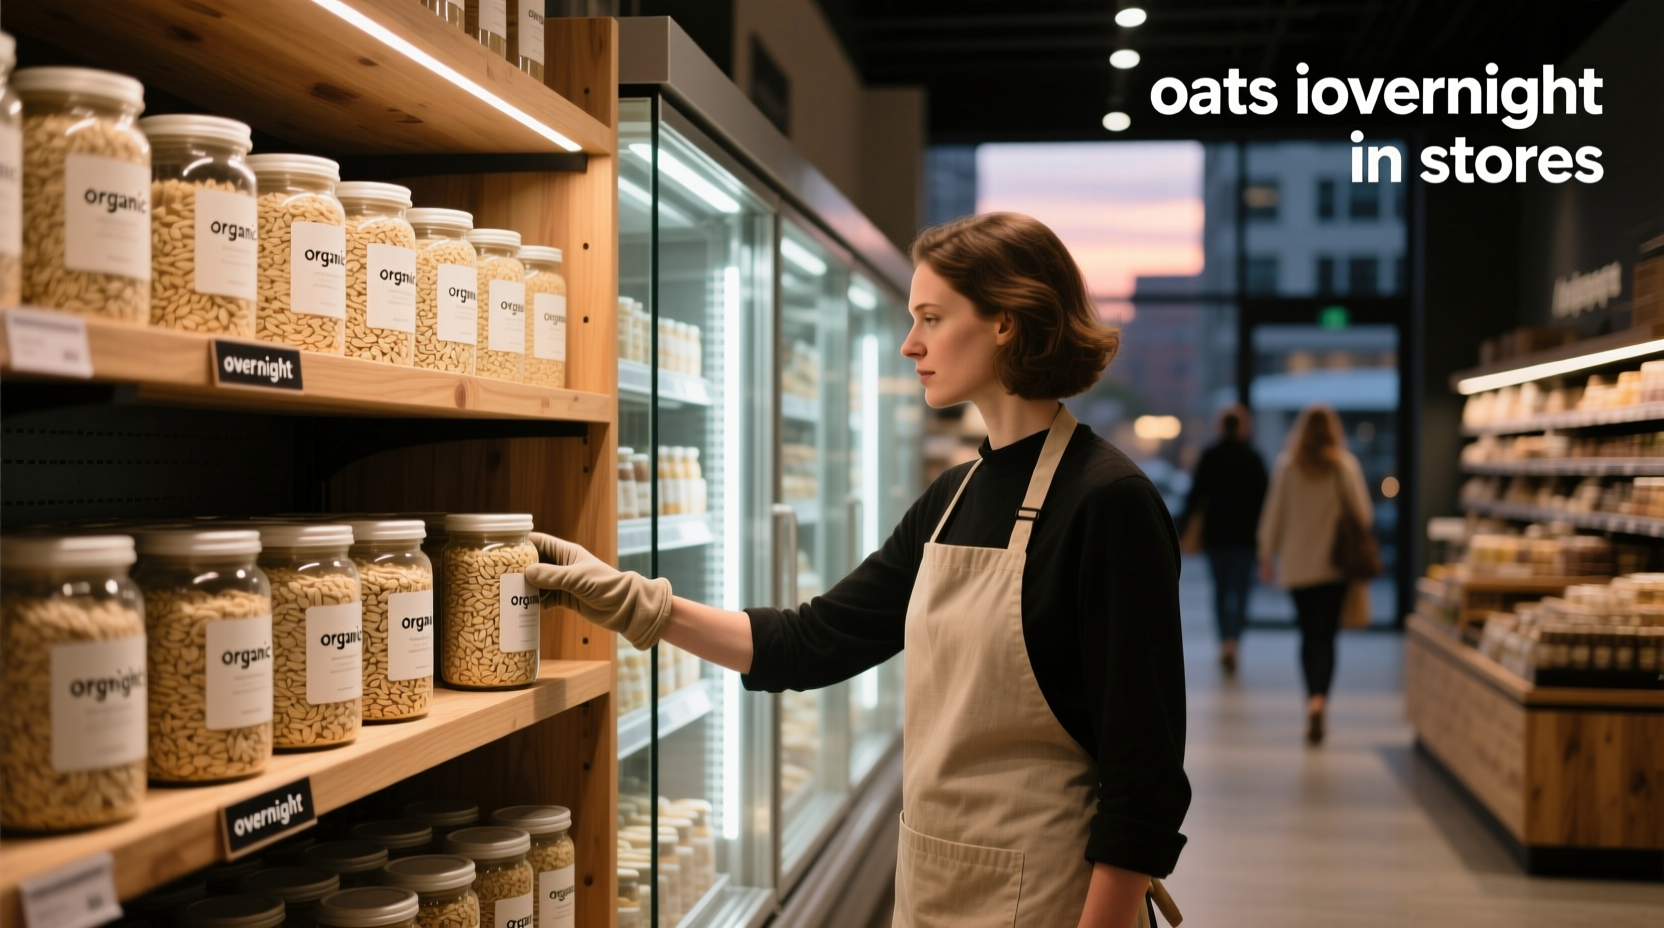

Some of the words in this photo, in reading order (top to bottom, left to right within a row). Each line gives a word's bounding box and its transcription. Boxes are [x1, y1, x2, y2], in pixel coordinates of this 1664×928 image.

[223, 355, 293, 383] overnight
[222, 641, 271, 669] organic
[234, 793, 304, 837] overnight
